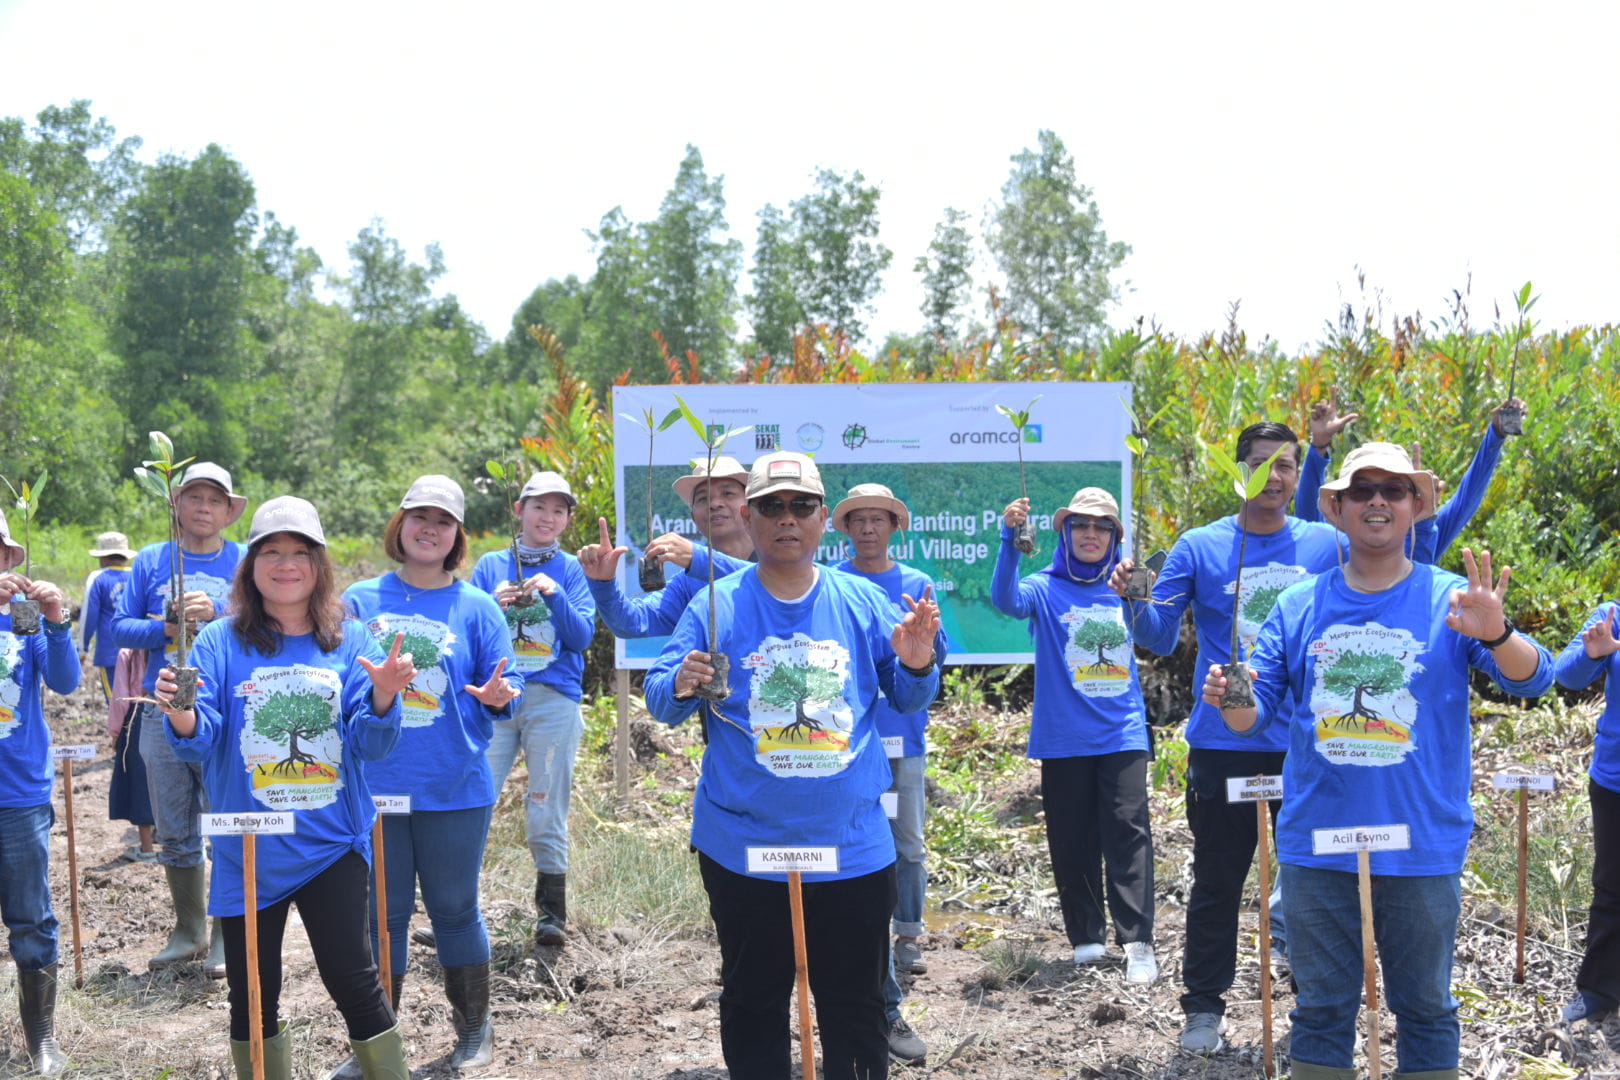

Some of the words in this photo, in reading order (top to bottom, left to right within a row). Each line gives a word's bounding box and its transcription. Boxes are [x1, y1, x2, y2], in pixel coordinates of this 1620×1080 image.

[755, 424, 780, 433] SEKAT
[950, 431, 1019, 444] aramco
[651, 514, 701, 534] Aram
[908, 511, 976, 535] lanting
[983, 510, 1053, 531] Prra
[814, 540, 851, 561] ruk
[886, 538, 913, 559] kul
[920, 538, 988, 564] Village
[1326, 742, 1345, 750] SAVE
[1347, 743, 1401, 752] MANGROVES
[770, 754, 792, 762] SAVE
[1327, 750, 1348, 758] SAVE
[1349, 750, 1367, 758] OUR
[1370, 750, 1398, 760] EARTH
[772, 762, 794, 770] SAVE
[816, 761, 843, 769] EARTH
[266, 789, 286, 797] SAVE
[287, 786, 334, 795] MANGROVES
[268, 796, 289, 804] SAVE
[310, 794, 333, 802] EARTH
[211, 817, 231, 827] Ms.
[264, 815, 284, 826] Koh
[1332, 833, 1353, 844] Acil
[1355, 832, 1390, 845] Esyno
[762, 852, 823, 862] KASMARNI
